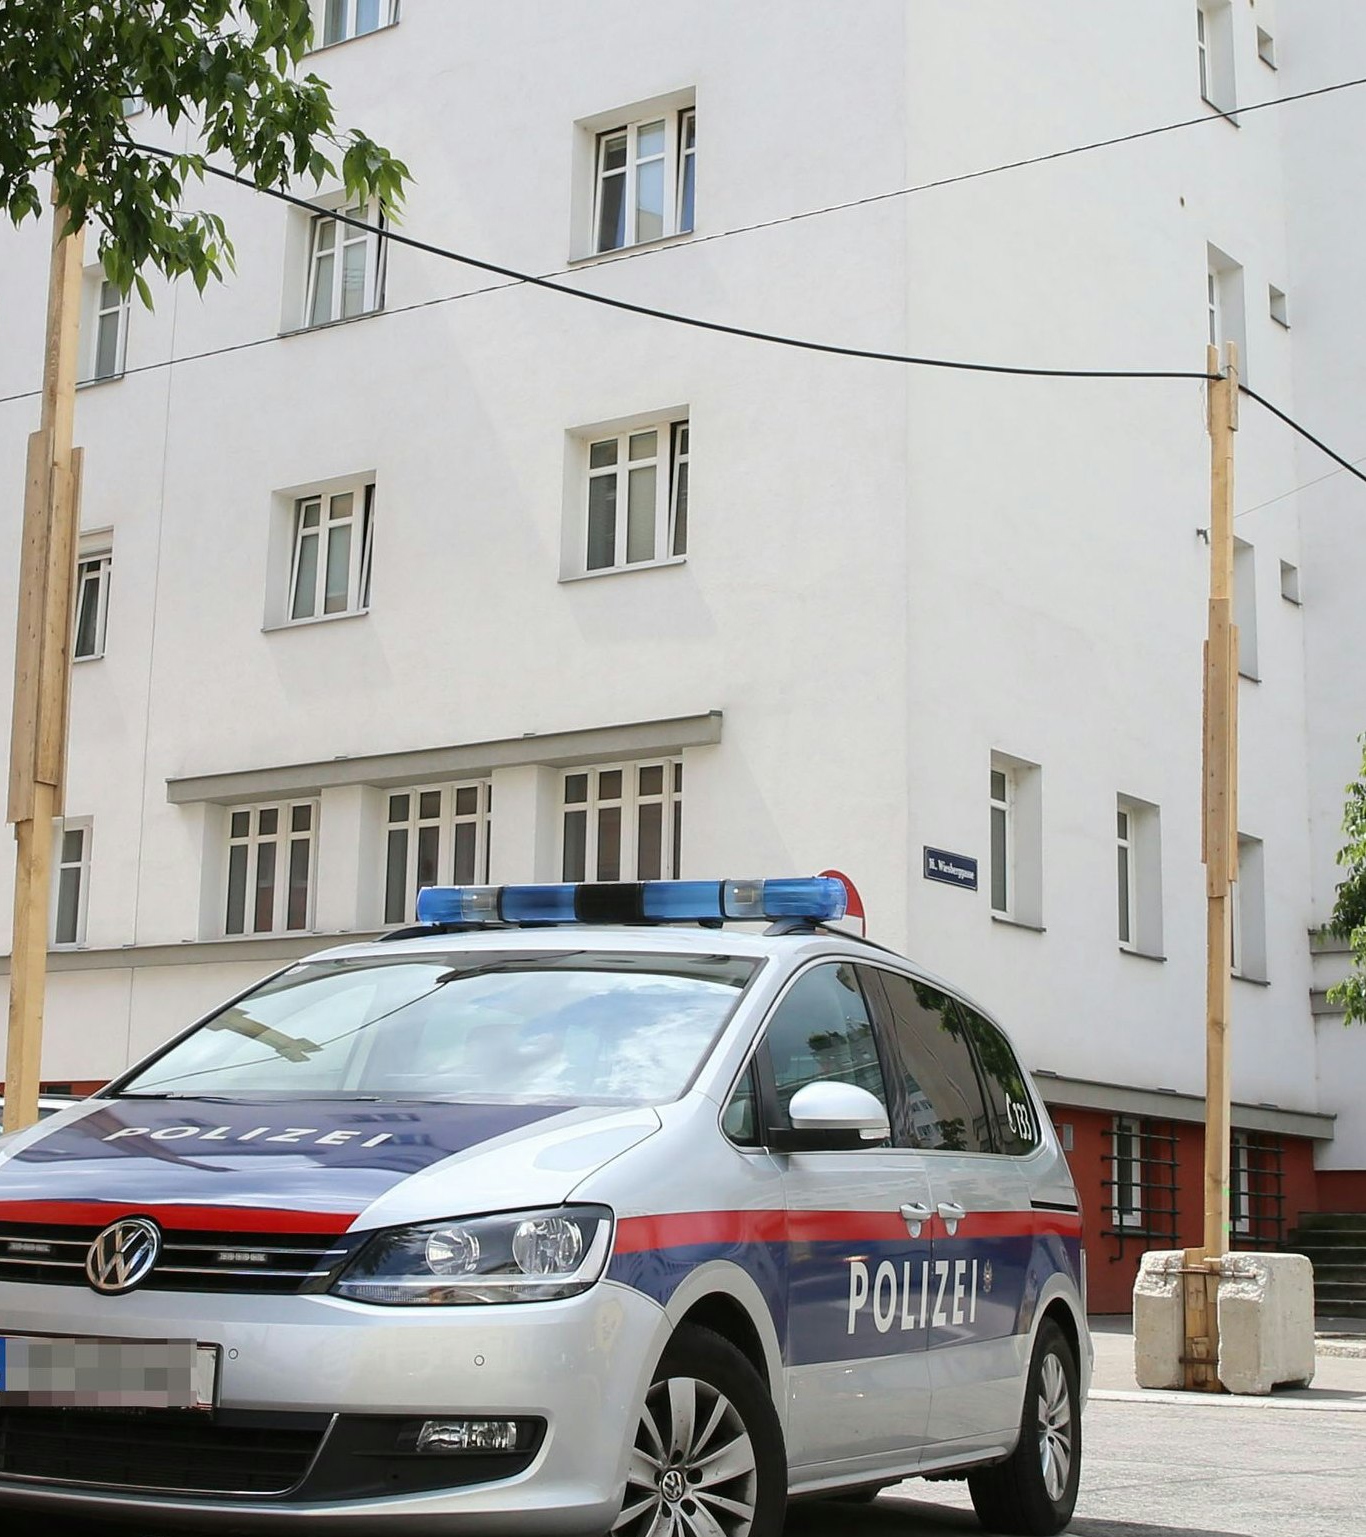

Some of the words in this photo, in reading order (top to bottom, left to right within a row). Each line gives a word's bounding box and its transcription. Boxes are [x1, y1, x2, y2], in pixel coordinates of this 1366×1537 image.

[102, 1126, 393, 1147] POLIZEI
[1012, 1102, 1032, 1140] 133
[86, 1218, 161, 1290] VW
[848, 1259, 978, 1335] POLIZEI
